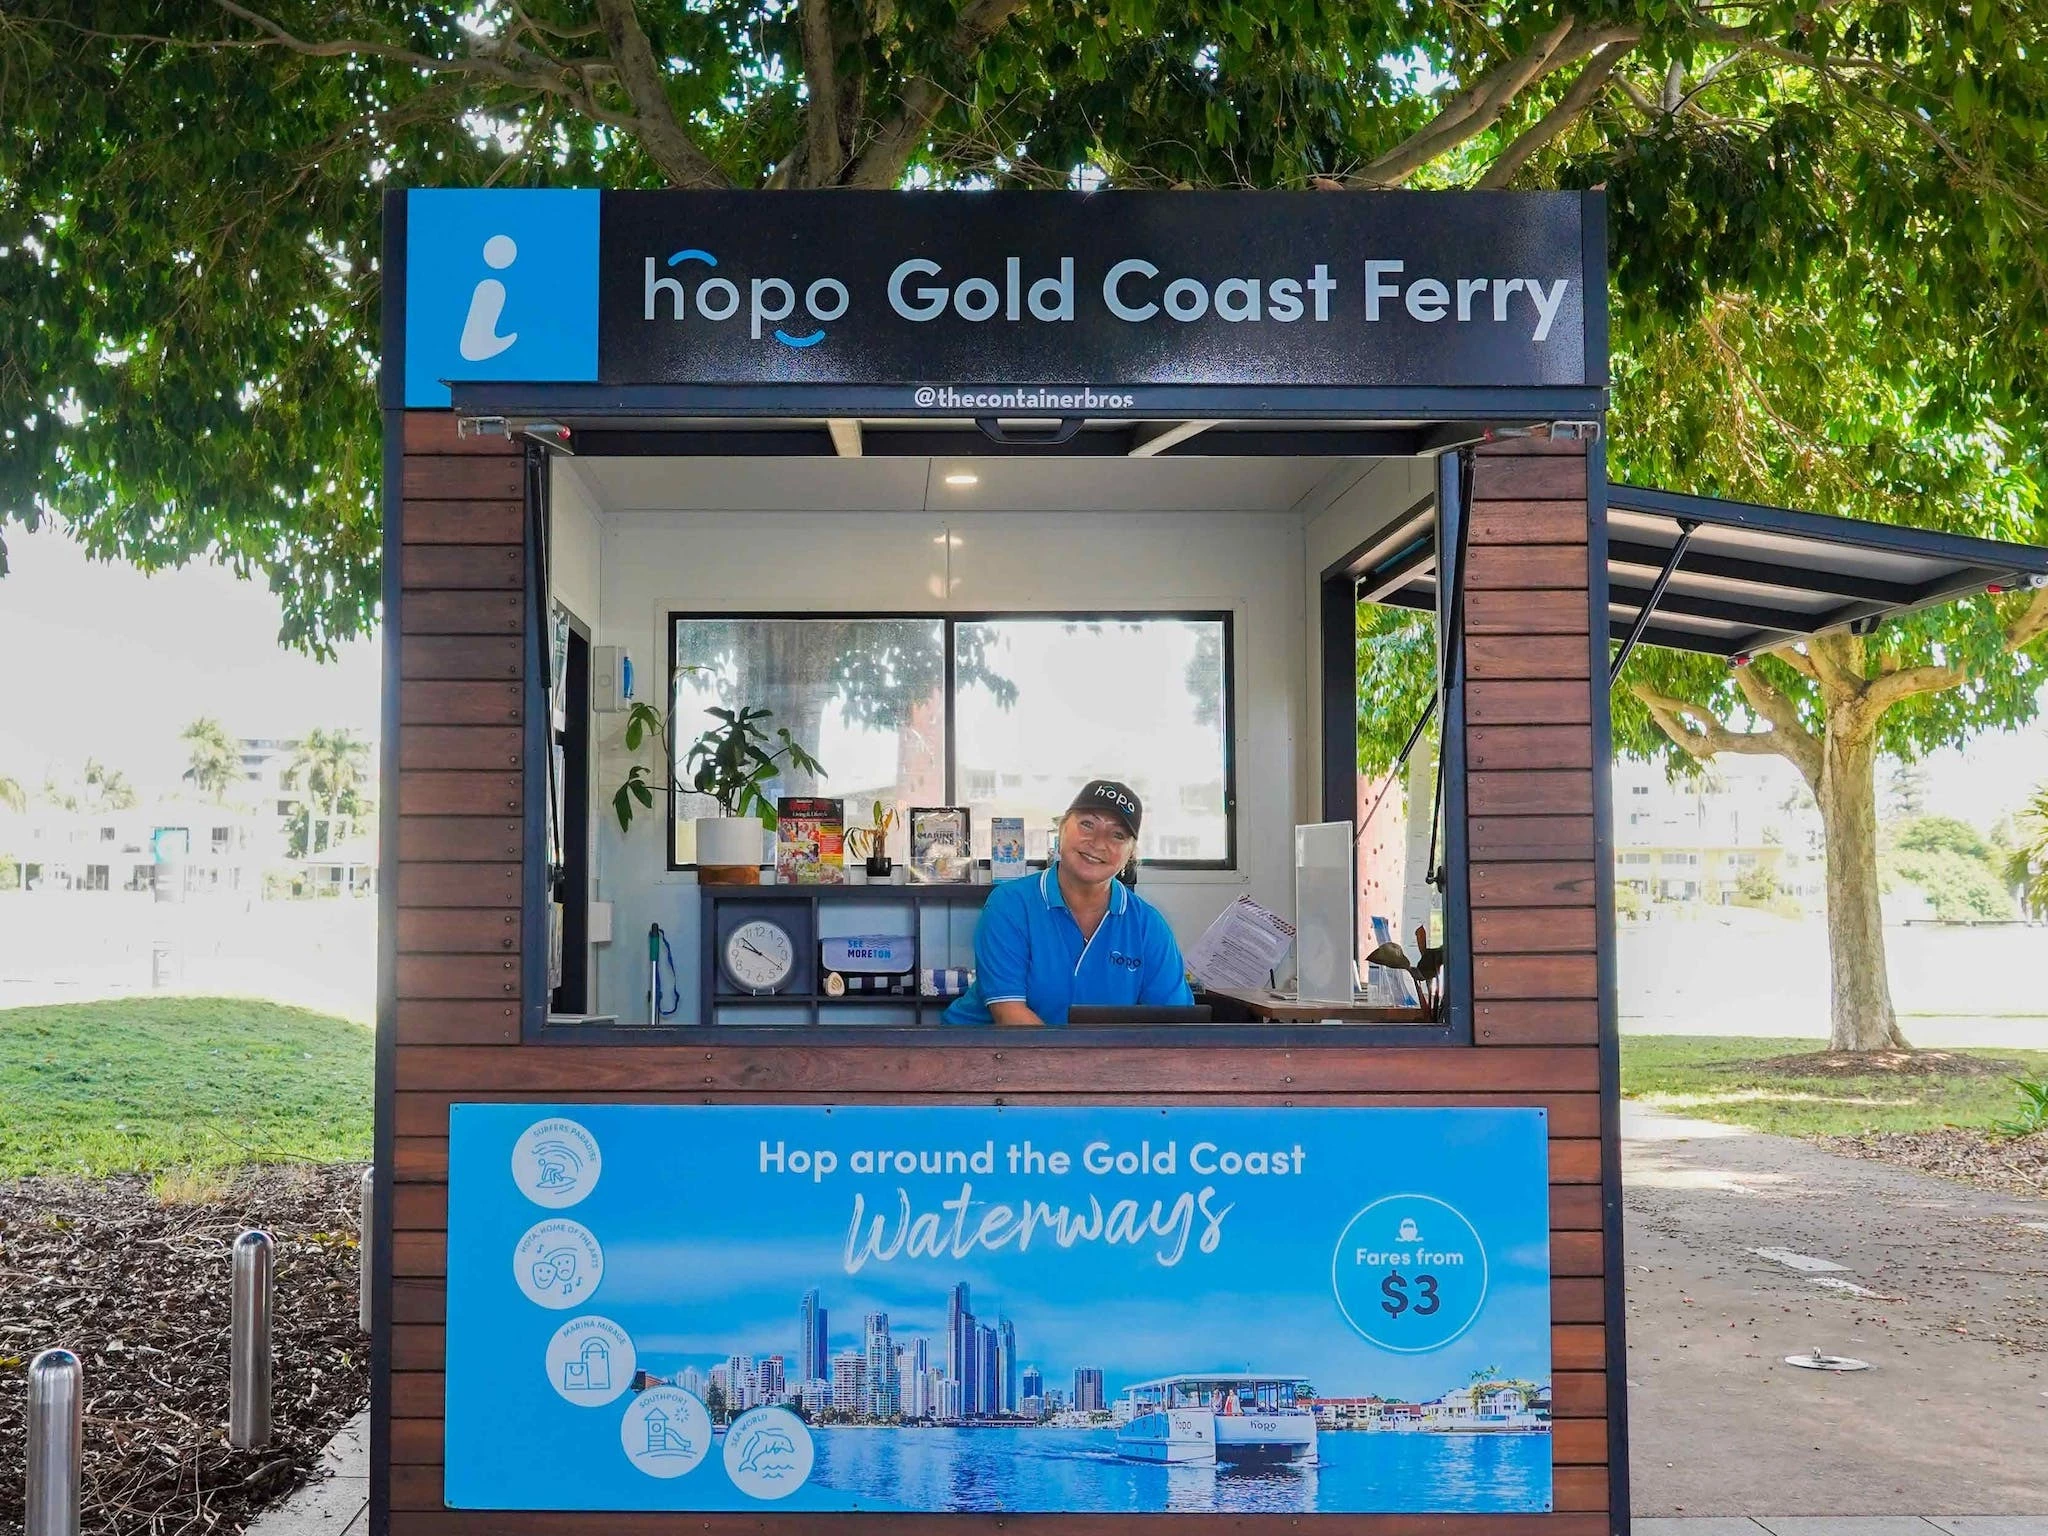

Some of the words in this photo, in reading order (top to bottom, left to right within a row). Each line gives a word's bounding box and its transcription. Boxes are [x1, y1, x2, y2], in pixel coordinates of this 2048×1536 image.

[644, 254, 850, 341] hopo
[887, 256, 1075, 322] Gold
[1103, 258, 1337, 323] Coast
[1364, 259, 1569, 341] Ferry
[914, 386, 1134, 408] @thecontainerbros
[1095, 785, 1136, 813] hopo
[755, 926, 765, 937] 12
[848, 939, 863, 948] SEE
[847, 949, 891, 959] MORETON
[1109, 952, 1142, 970] hopo
[735, 960, 743, 971] 8
[756, 972, 764, 982] 6
[533, 1123, 569, 1137] SURFERS
[759, 1140, 837, 1182] Hop
[850, 1140, 993, 1175] around
[1006, 1141, 1070, 1175] the
[1082, 1141, 1176, 1176] Gold
[1190, 1141, 1306, 1175] Coast
[843, 1182, 1235, 1274] Waterways
[540, 1224, 566, 1234] HOME
[567, 1225, 578, 1234] OF
[579, 1232, 592, 1248] THE
[588, 1248, 599, 1269] ARTS
[1356, 1248, 1411, 1266] Fares
[1416, 1248, 1464, 1266] from
[1381, 1269, 1440, 1320] $3
[563, 1320, 595, 1337] MARINA
[597, 1321, 627, 1345] MIRAGE
[639, 1392, 688, 1409] SOUTHPORT
[730, 1431, 743, 1448] SEA
[741, 1413, 768, 1433] WORLD
[1250, 1420, 1277, 1432] hopo
